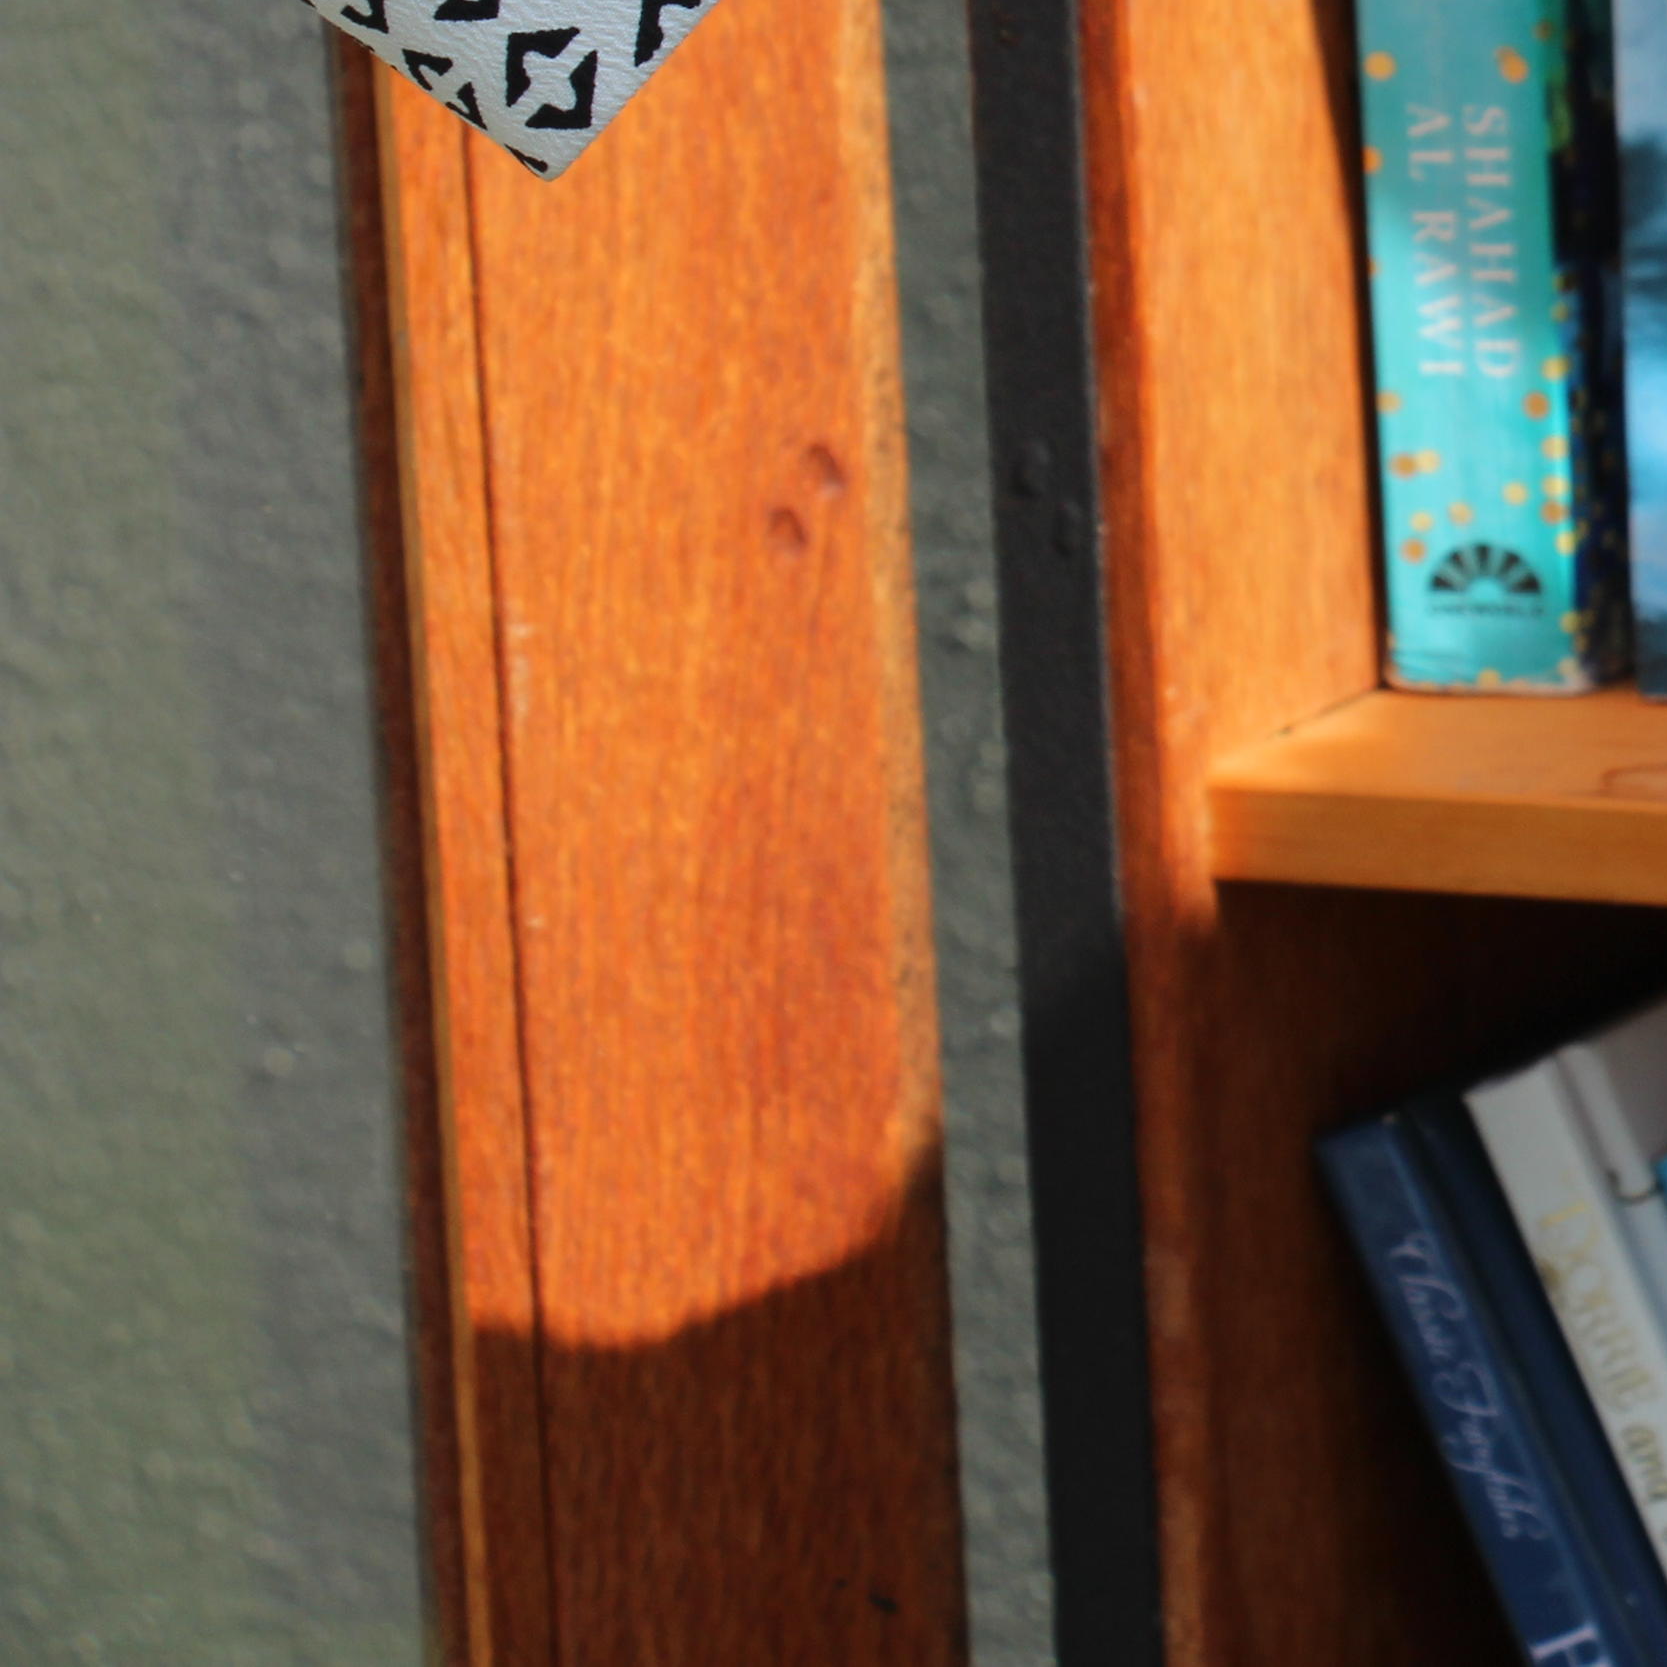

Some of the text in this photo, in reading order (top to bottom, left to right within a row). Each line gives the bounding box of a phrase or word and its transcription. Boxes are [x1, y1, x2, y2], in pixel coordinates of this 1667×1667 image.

[1405, 104, 1464, 379] AL RAWI
[1461, 104, 1524, 383] SHAHAD
